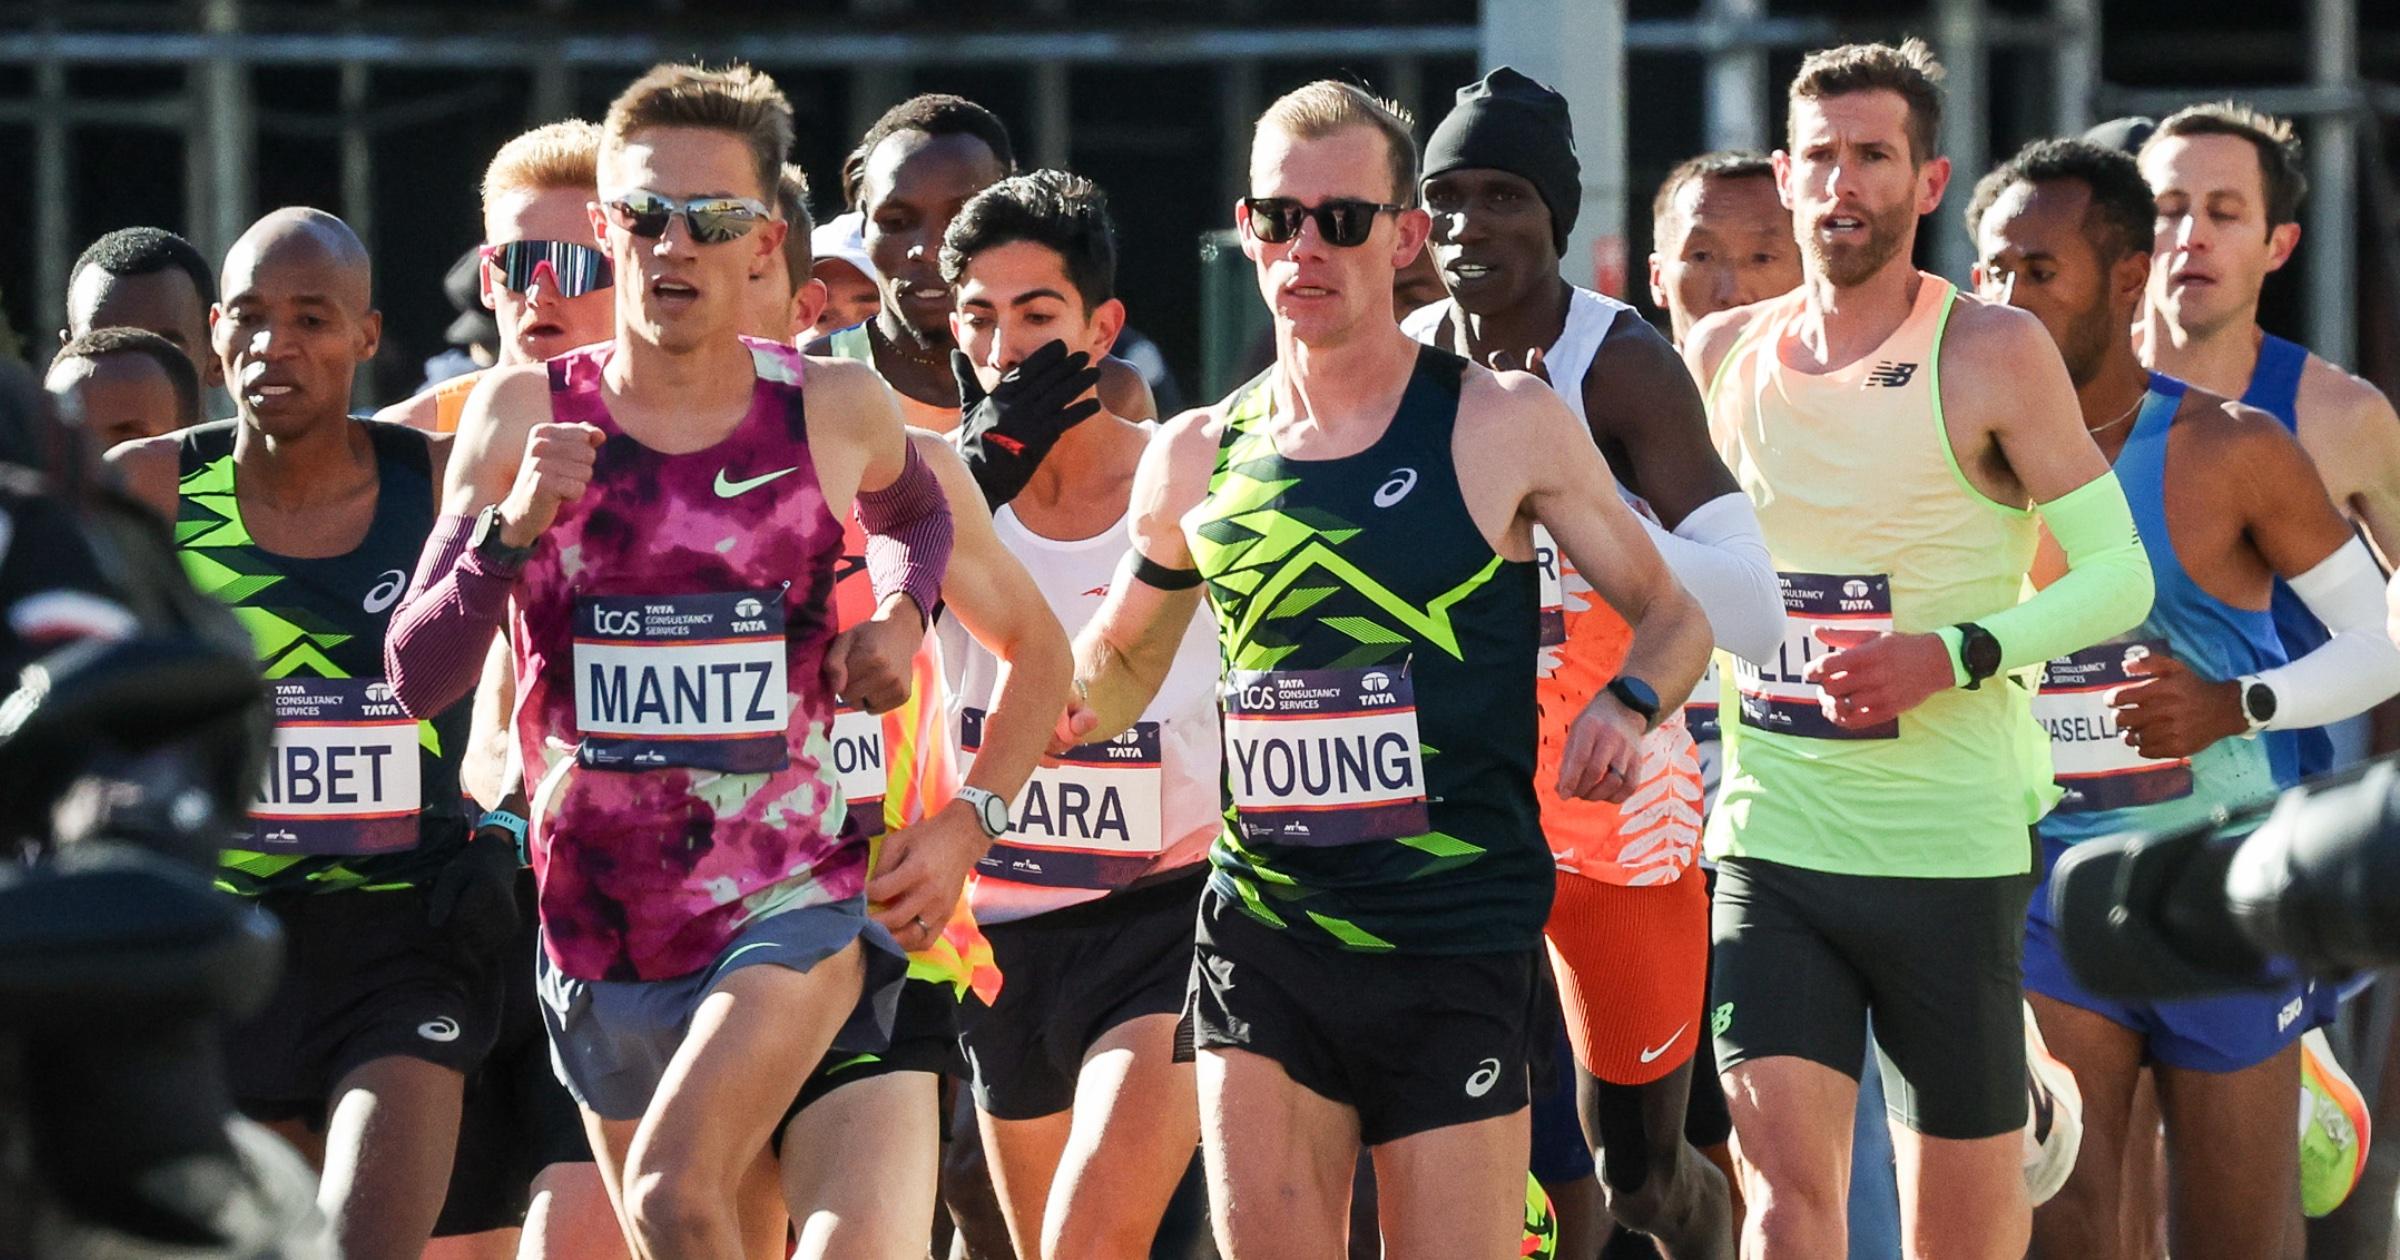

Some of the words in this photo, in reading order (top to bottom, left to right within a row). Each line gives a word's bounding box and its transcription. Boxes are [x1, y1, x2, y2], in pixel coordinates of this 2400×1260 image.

[645, 605, 674, 615] TATA
[1840, 599, 1874, 611] TATA
[594, 603, 641, 636] tcs
[645, 613, 714, 625] CONSULTANCY
[645, 626, 690, 636] SERVICES
[731, 620, 767, 633] TATA
[1278, 678, 1305, 689] TATA
[276, 685, 306, 695] TATA
[590, 660, 775, 725] MANTZ
[1278, 688, 1341, 700] CONSULTANCY
[276, 695, 344, 706] CONSULTANCY
[1279, 699, 1320, 710] SERVICES
[1359, 692, 1396, 706] TATA
[276, 706, 321, 716] SERVICES
[361, 704, 399, 716] TATA
[833, 733, 881, 774] ON
[1106, 747, 1143, 759] TATA
[1233, 731, 1414, 797] YOUNG
[255, 744, 392, 804] IBET
[1008, 780, 1130, 842] ARA
